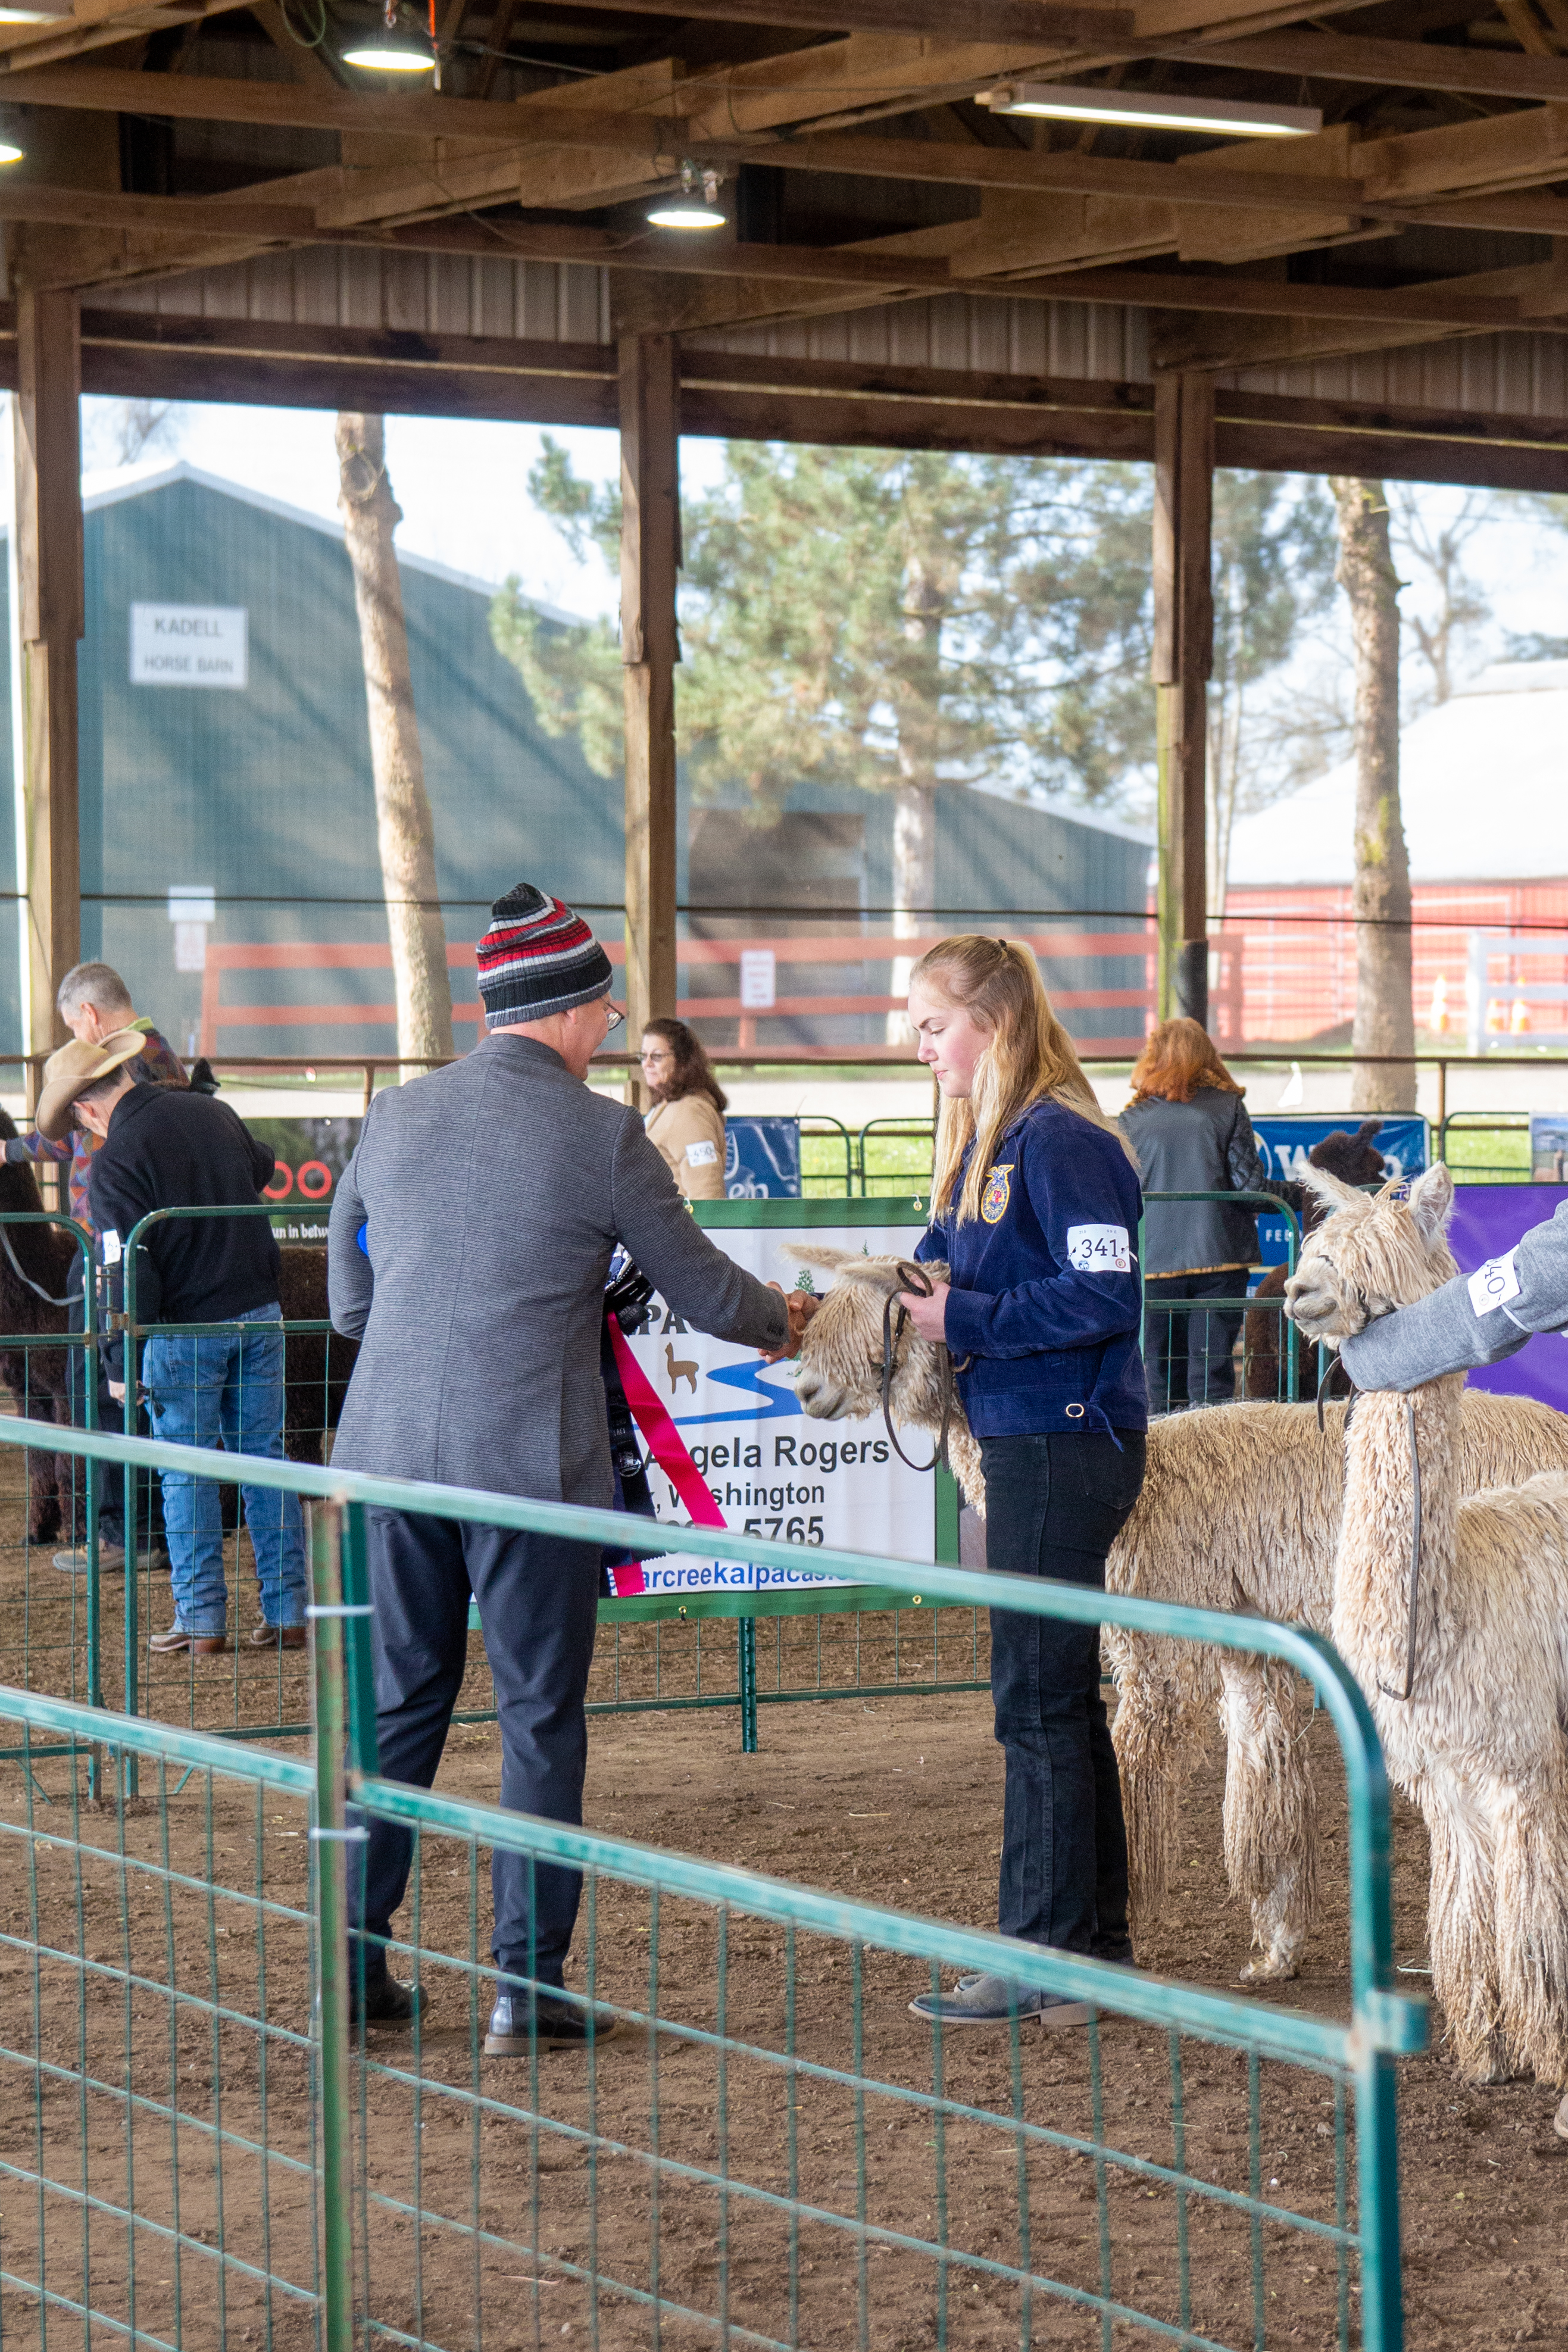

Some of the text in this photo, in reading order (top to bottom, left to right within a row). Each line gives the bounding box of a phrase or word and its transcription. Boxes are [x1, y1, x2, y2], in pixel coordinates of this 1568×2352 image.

[271, 1225, 286, 1238] un
[288, 1223, 299, 1238] in
[1081, 1238, 1118, 1258] 341
[644, 1436, 889, 1476] Agela Rogers
